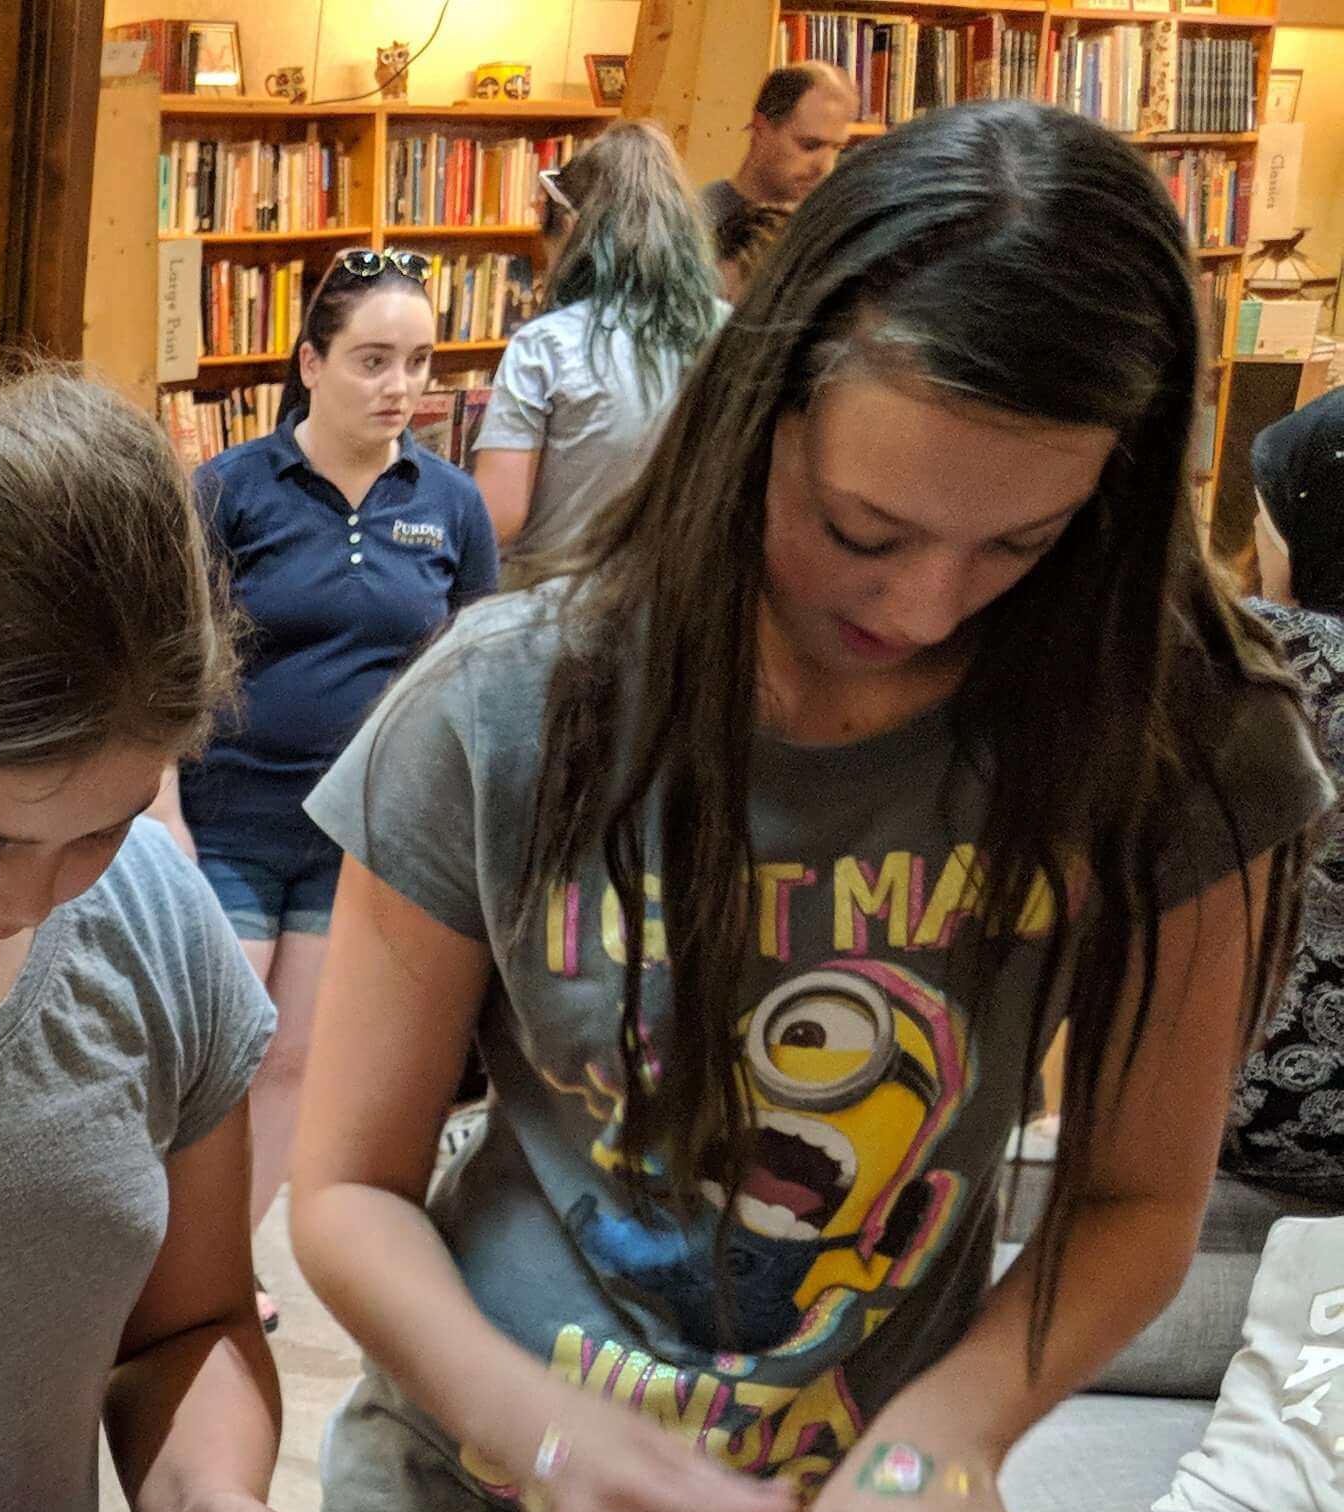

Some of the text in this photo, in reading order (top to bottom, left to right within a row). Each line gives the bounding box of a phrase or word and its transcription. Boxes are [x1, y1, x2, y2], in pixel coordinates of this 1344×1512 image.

[1265, 152, 1285, 210] Classics
[164, 257, 184, 362] Large Print
[393, 519, 445, 541] PURDUE
[600, 865, 816, 965] GT
